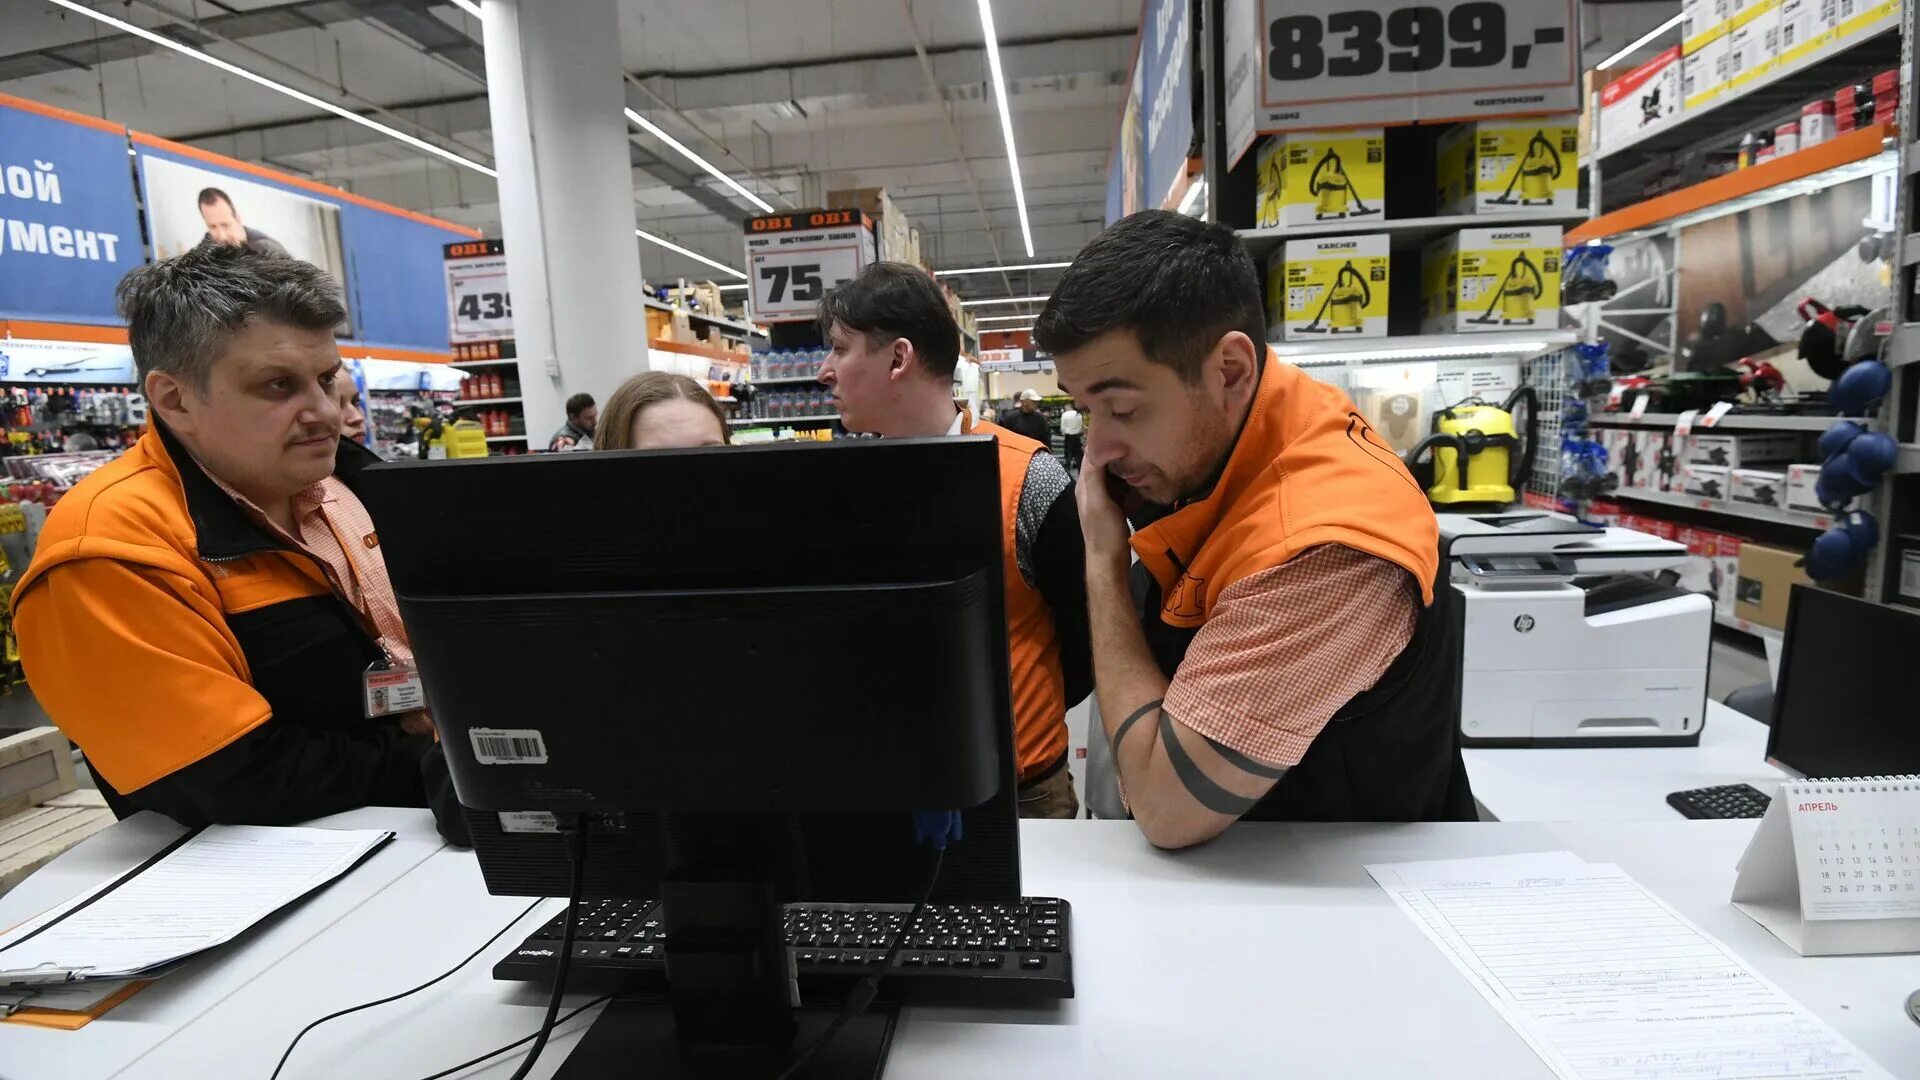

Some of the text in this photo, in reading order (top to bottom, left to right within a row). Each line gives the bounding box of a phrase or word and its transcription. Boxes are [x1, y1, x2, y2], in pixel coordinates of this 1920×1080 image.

[1268, 2, 1564, 81] 8399,-
[0, 159, 62, 204] ой
[751, 217, 793, 231] OBI
[810, 211, 851, 226] OBI
[0, 218, 119, 262] мент
[450, 243, 488, 257] OBI
[458, 292, 512, 321] 43
[1515, 615, 1534, 633] hp
[1798, 802, 1838, 812] АПРЕЛЬ
